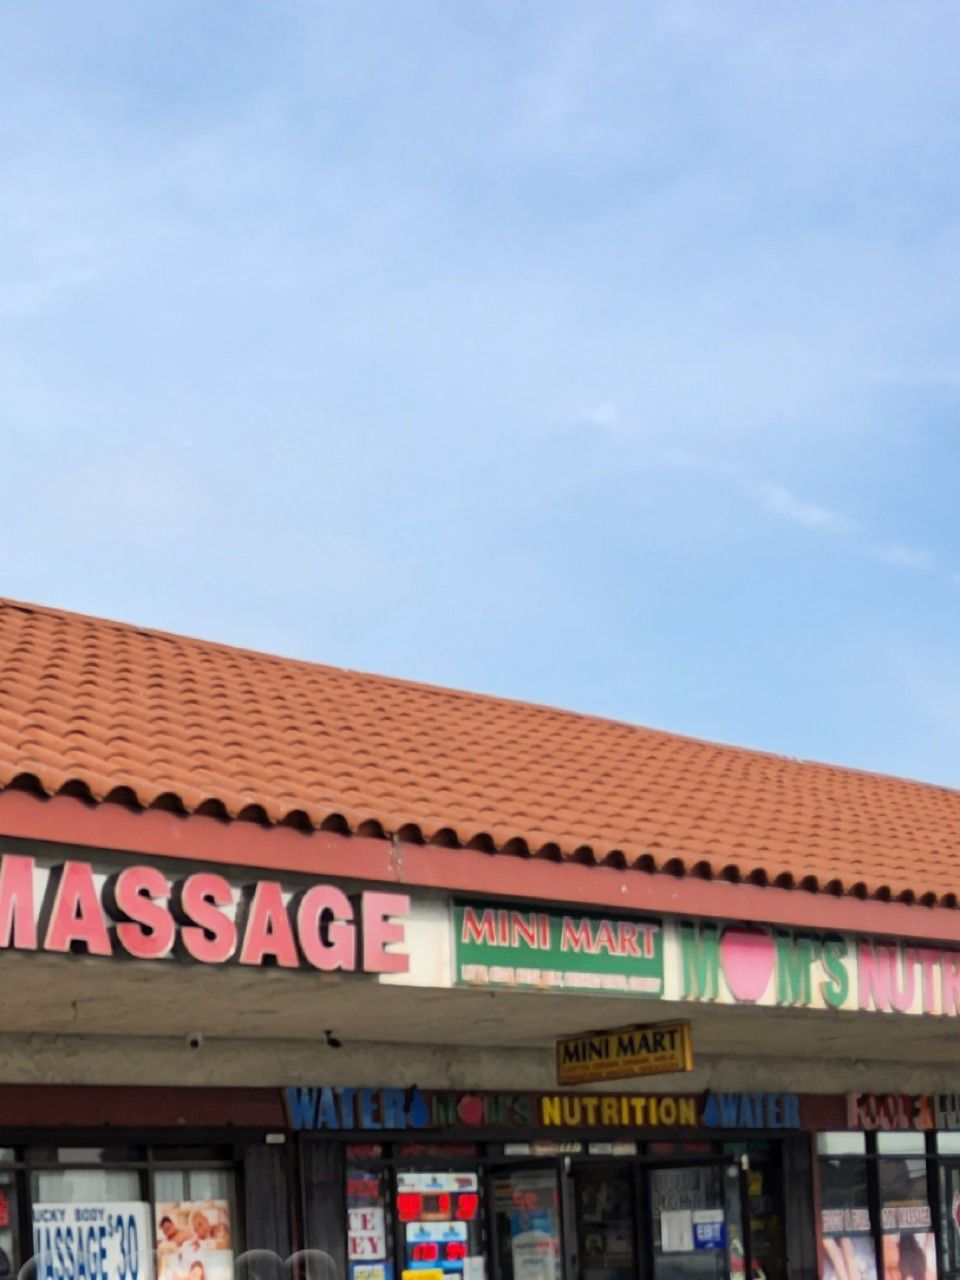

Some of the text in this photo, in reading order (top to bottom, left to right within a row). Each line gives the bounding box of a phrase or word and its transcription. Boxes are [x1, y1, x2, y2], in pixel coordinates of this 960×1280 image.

[461, 906, 660, 960] MINI MART
[562, 1030, 679, 1064] MINI MART
[288, 1087, 407, 1130] WATER
[542, 1096, 696, 1126] NUTRITION
[719, 1093, 801, 1129] WATER
